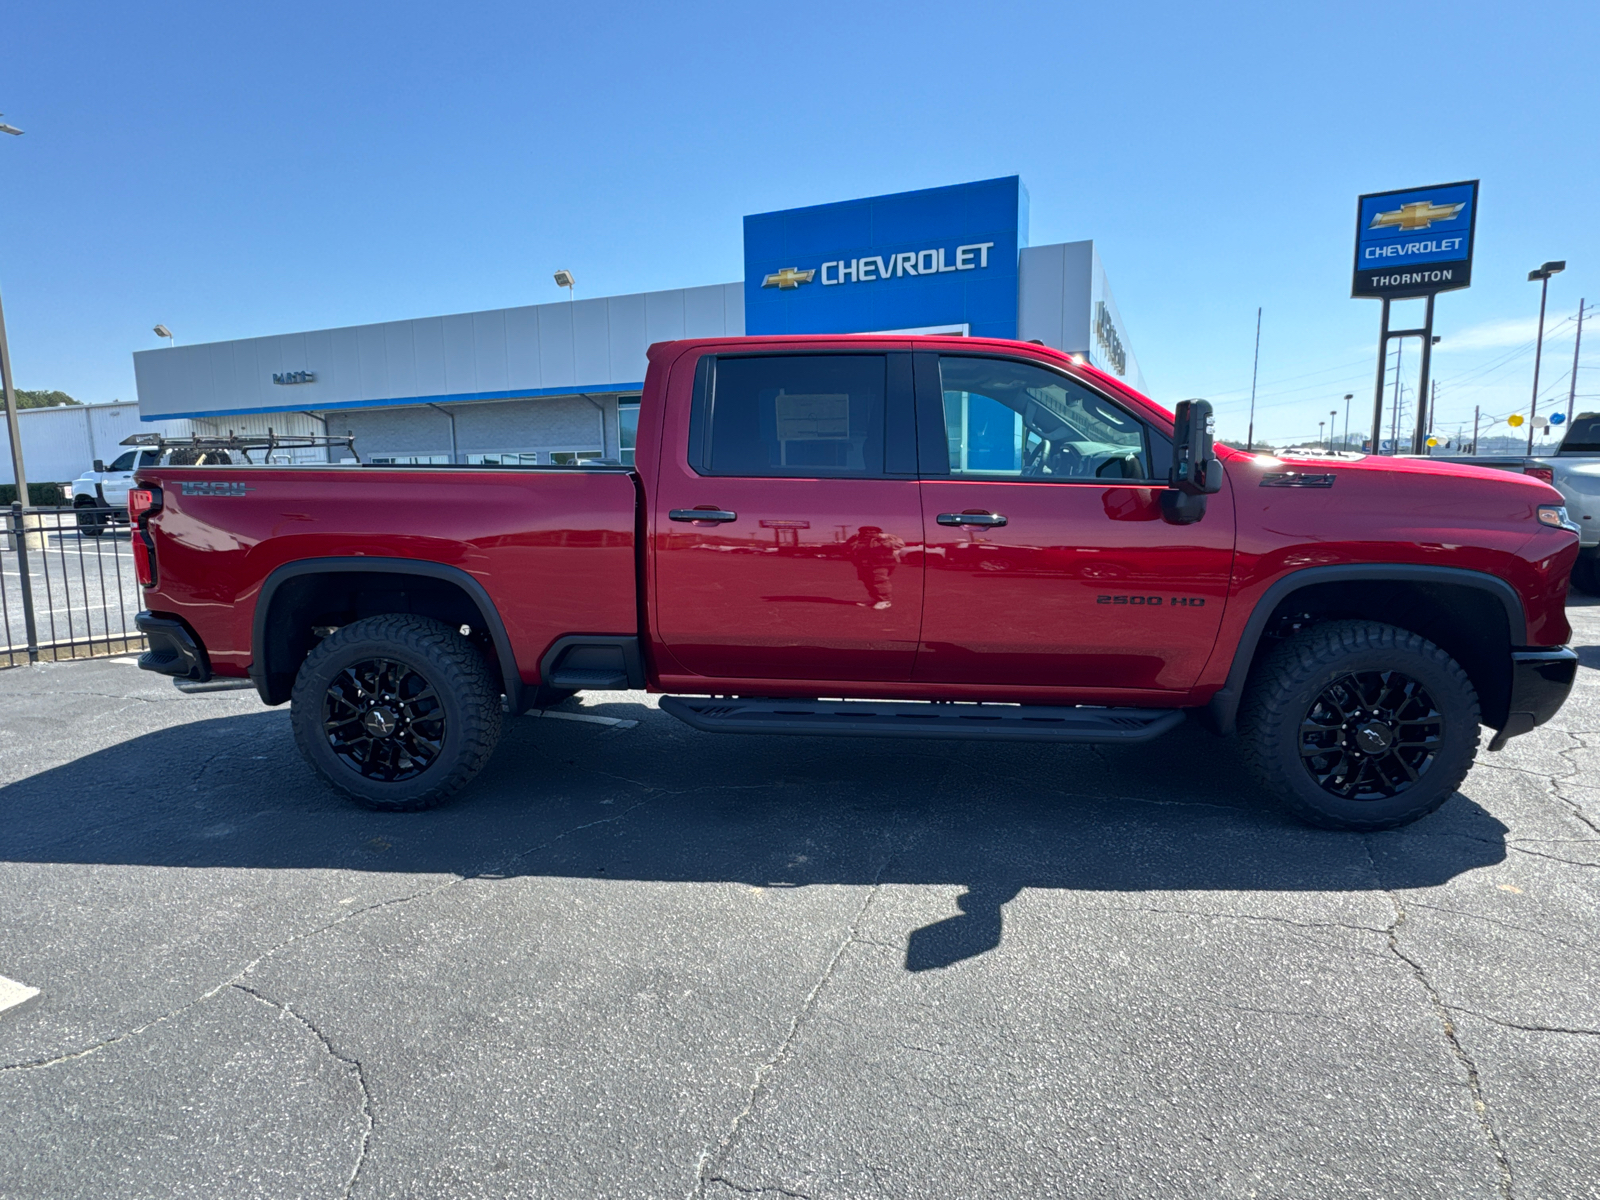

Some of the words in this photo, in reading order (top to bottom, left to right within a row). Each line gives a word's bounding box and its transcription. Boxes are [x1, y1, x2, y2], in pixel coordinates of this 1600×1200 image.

[1365, 237, 1463, 259] CHEVROLET
[821, 241, 994, 286] CHEVROLET
[1371, 269, 1453, 287] THORNTON
[1097, 595, 1162, 605] 2500
[1171, 597, 1205, 606] HD
